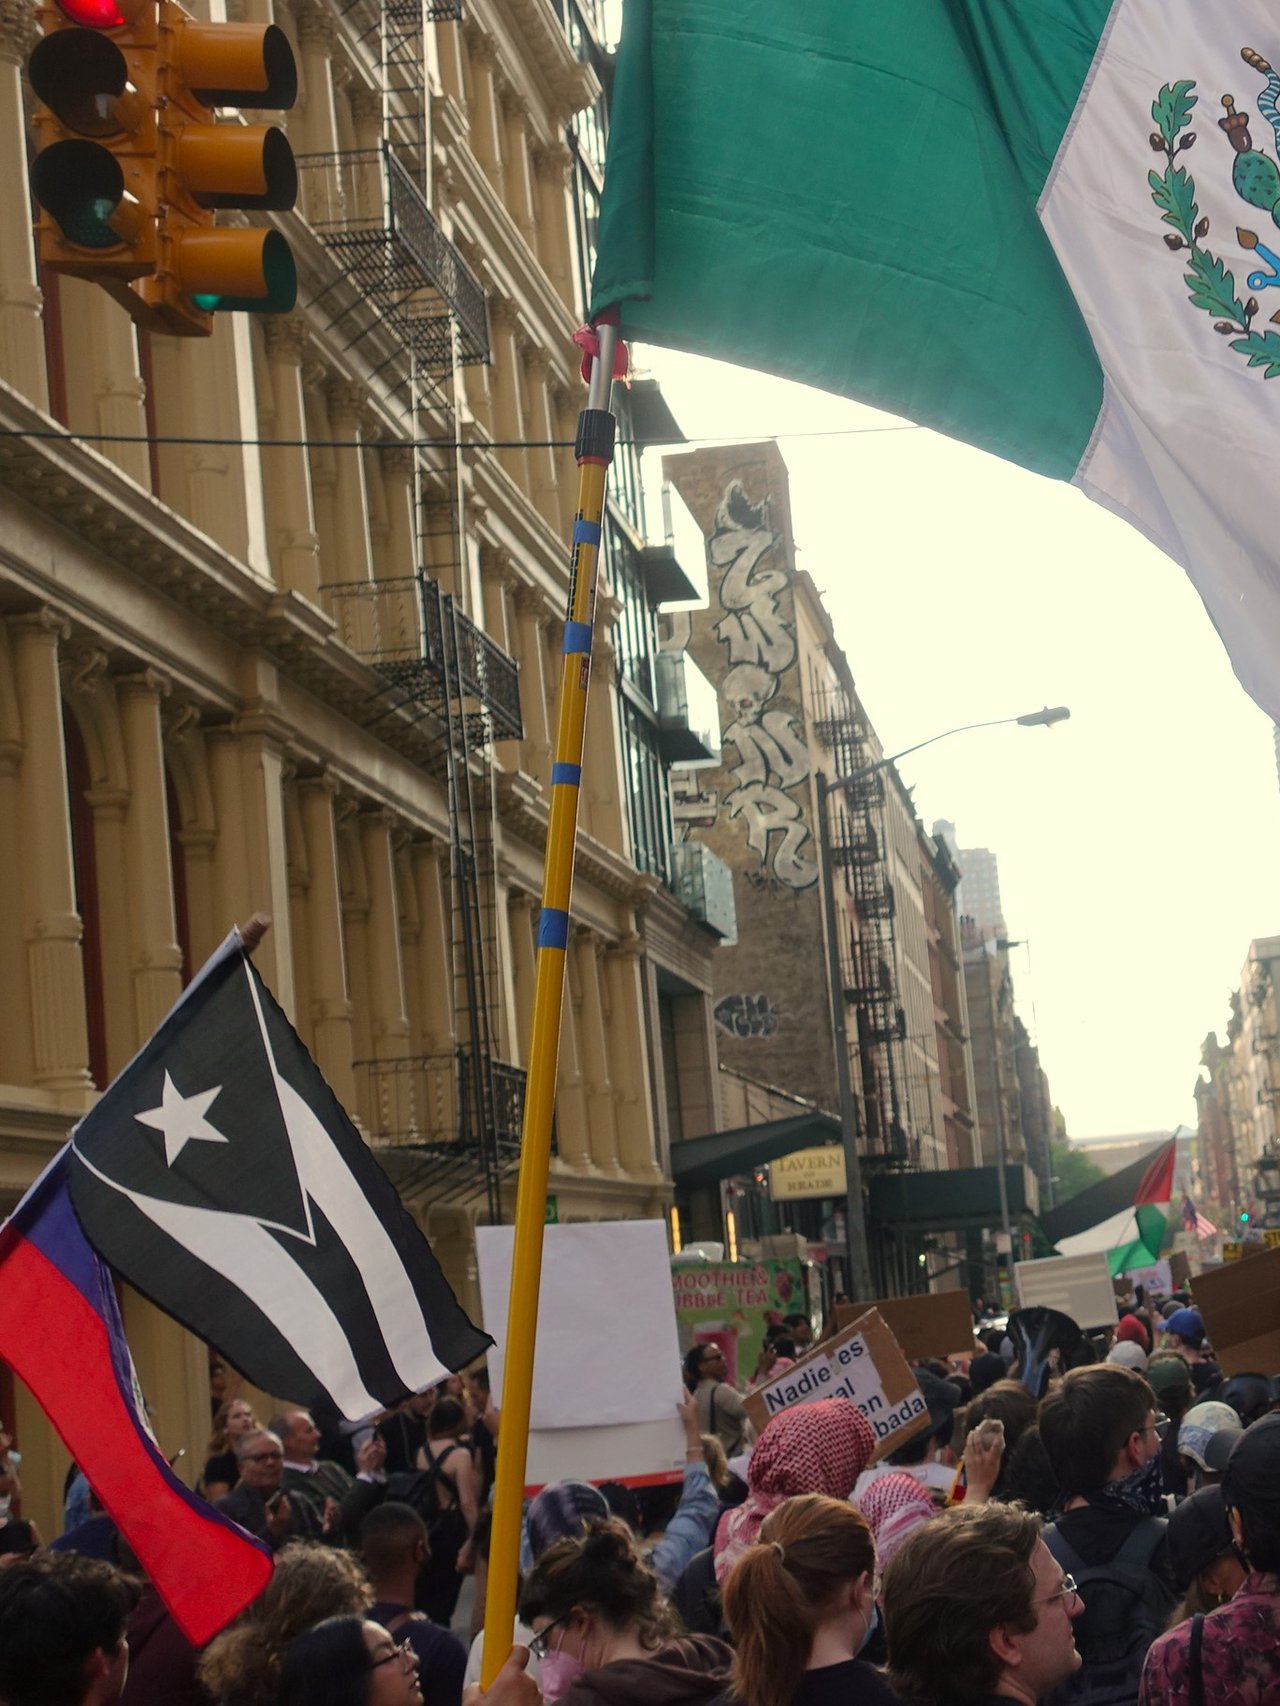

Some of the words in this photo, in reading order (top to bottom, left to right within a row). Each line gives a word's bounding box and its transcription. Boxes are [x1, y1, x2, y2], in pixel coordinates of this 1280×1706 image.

[778, 1153, 842, 1173] TAVERN
[736, 1288, 769, 1305] TEA
[765, 1365, 831, 1412] Nadie
[838, 1340, 864, 1366] es
[873, 1397, 925, 1438] bada
